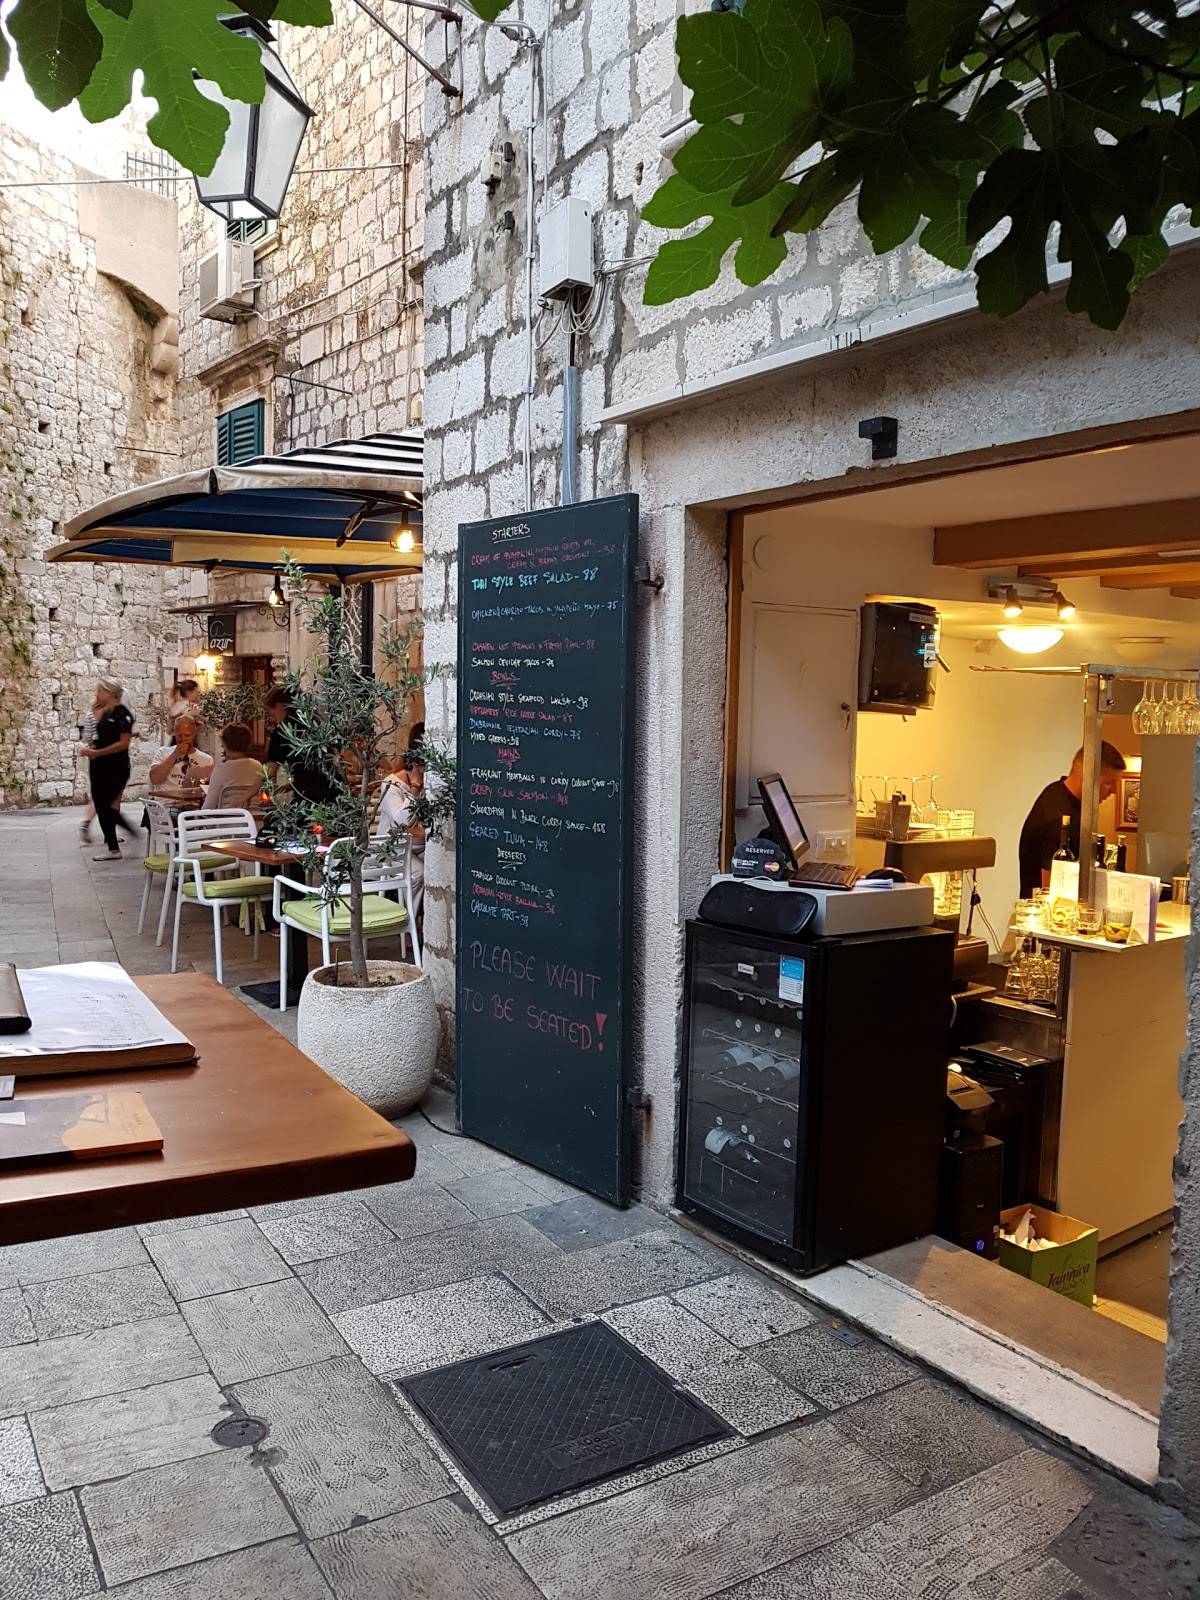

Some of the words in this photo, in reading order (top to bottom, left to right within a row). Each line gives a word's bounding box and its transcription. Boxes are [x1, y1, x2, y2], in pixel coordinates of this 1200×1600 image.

[492, 523, 530, 540] STARTERS
[518, 575, 538, 587] BEEF
[210, 638, 234, 651] azur
[497, 847, 527, 862] DESSERTS
[745, 847, 775, 855] RESERVED
[470, 940, 536, 982] PLEASE
[546, 961, 601, 1000] WAIT
[463, 987, 484, 1012] TO
[490, 994, 514, 1022] BE
